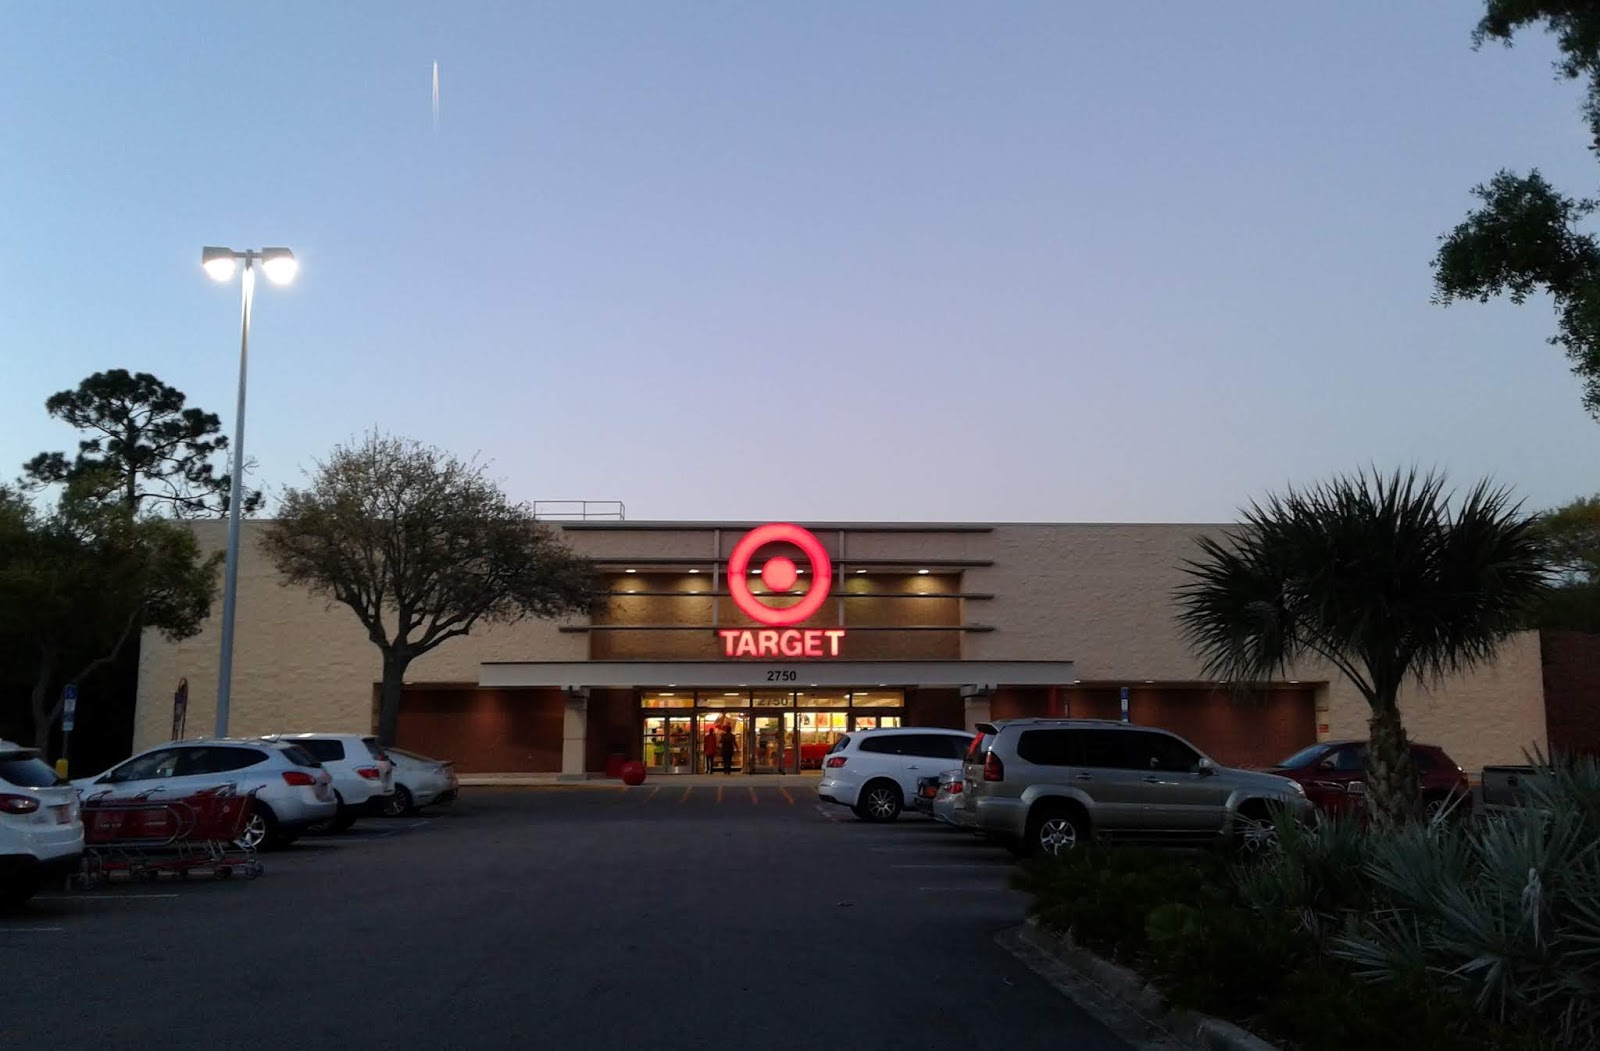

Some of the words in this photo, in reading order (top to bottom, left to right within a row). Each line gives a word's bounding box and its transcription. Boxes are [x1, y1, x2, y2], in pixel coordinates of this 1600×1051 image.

[719, 630, 845, 656] TARGET
[767, 671, 797, 681] 2750
[758, 697, 788, 706] 2750
